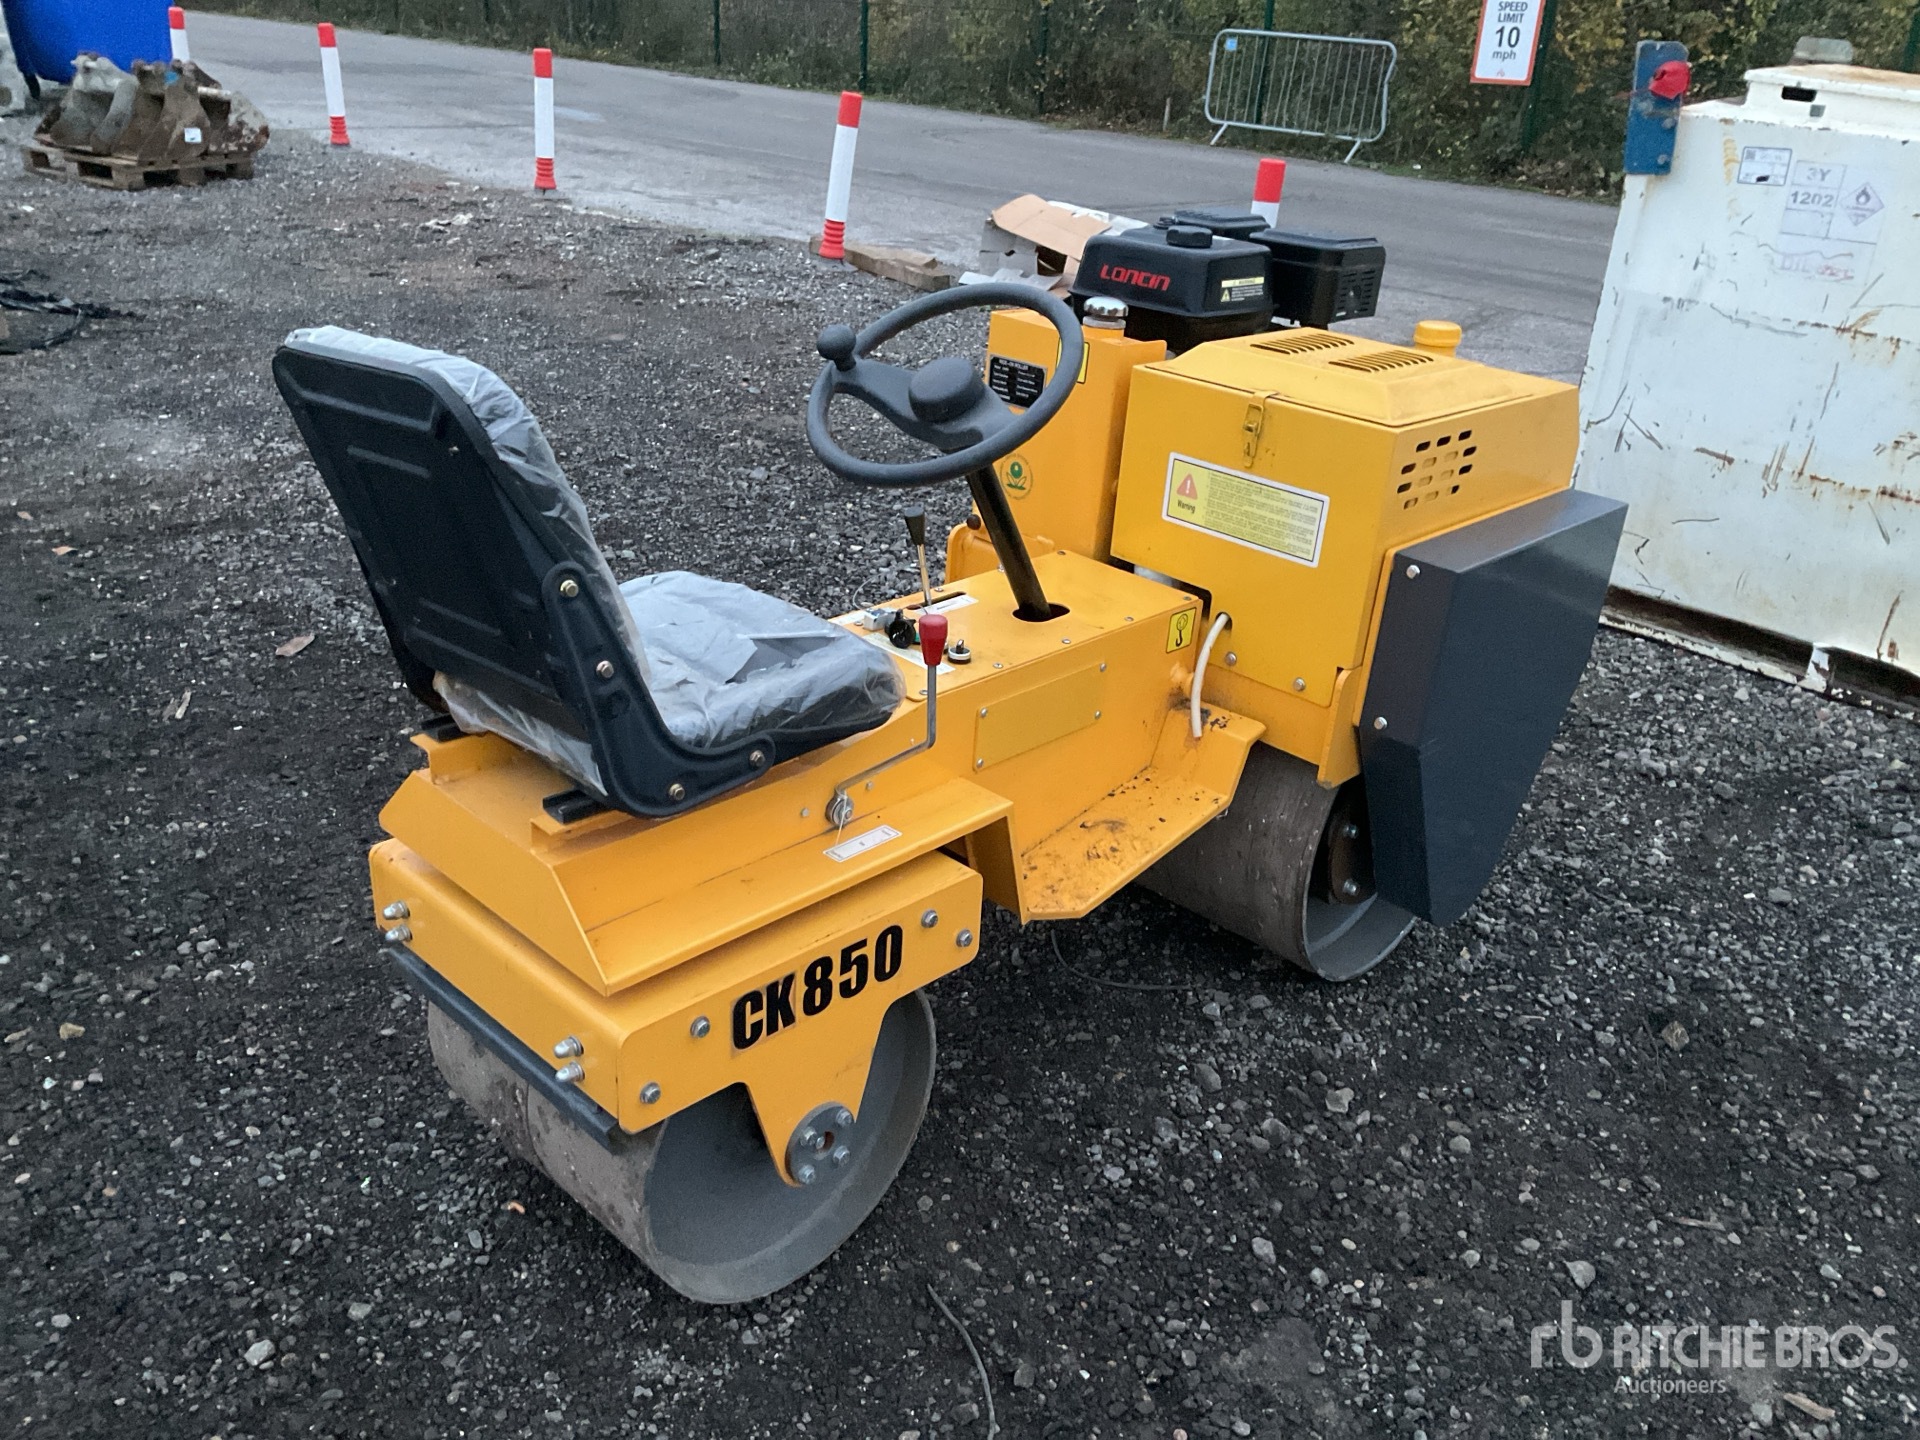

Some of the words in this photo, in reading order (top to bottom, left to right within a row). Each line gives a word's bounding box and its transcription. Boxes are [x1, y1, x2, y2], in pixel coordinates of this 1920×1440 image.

[1497, 1, 1528, 12] SPEED
[1497, 13, 1524, 24] LIMIT
[1495, 26, 1521, 48] 10
[1492, 50, 1516, 62] mph
[1806, 167, 1832, 182] 3Y
[1790, 190, 1835, 208] 1202
[1177, 499, 1196, 514] Warning
[732, 924, 904, 1050] CK850
